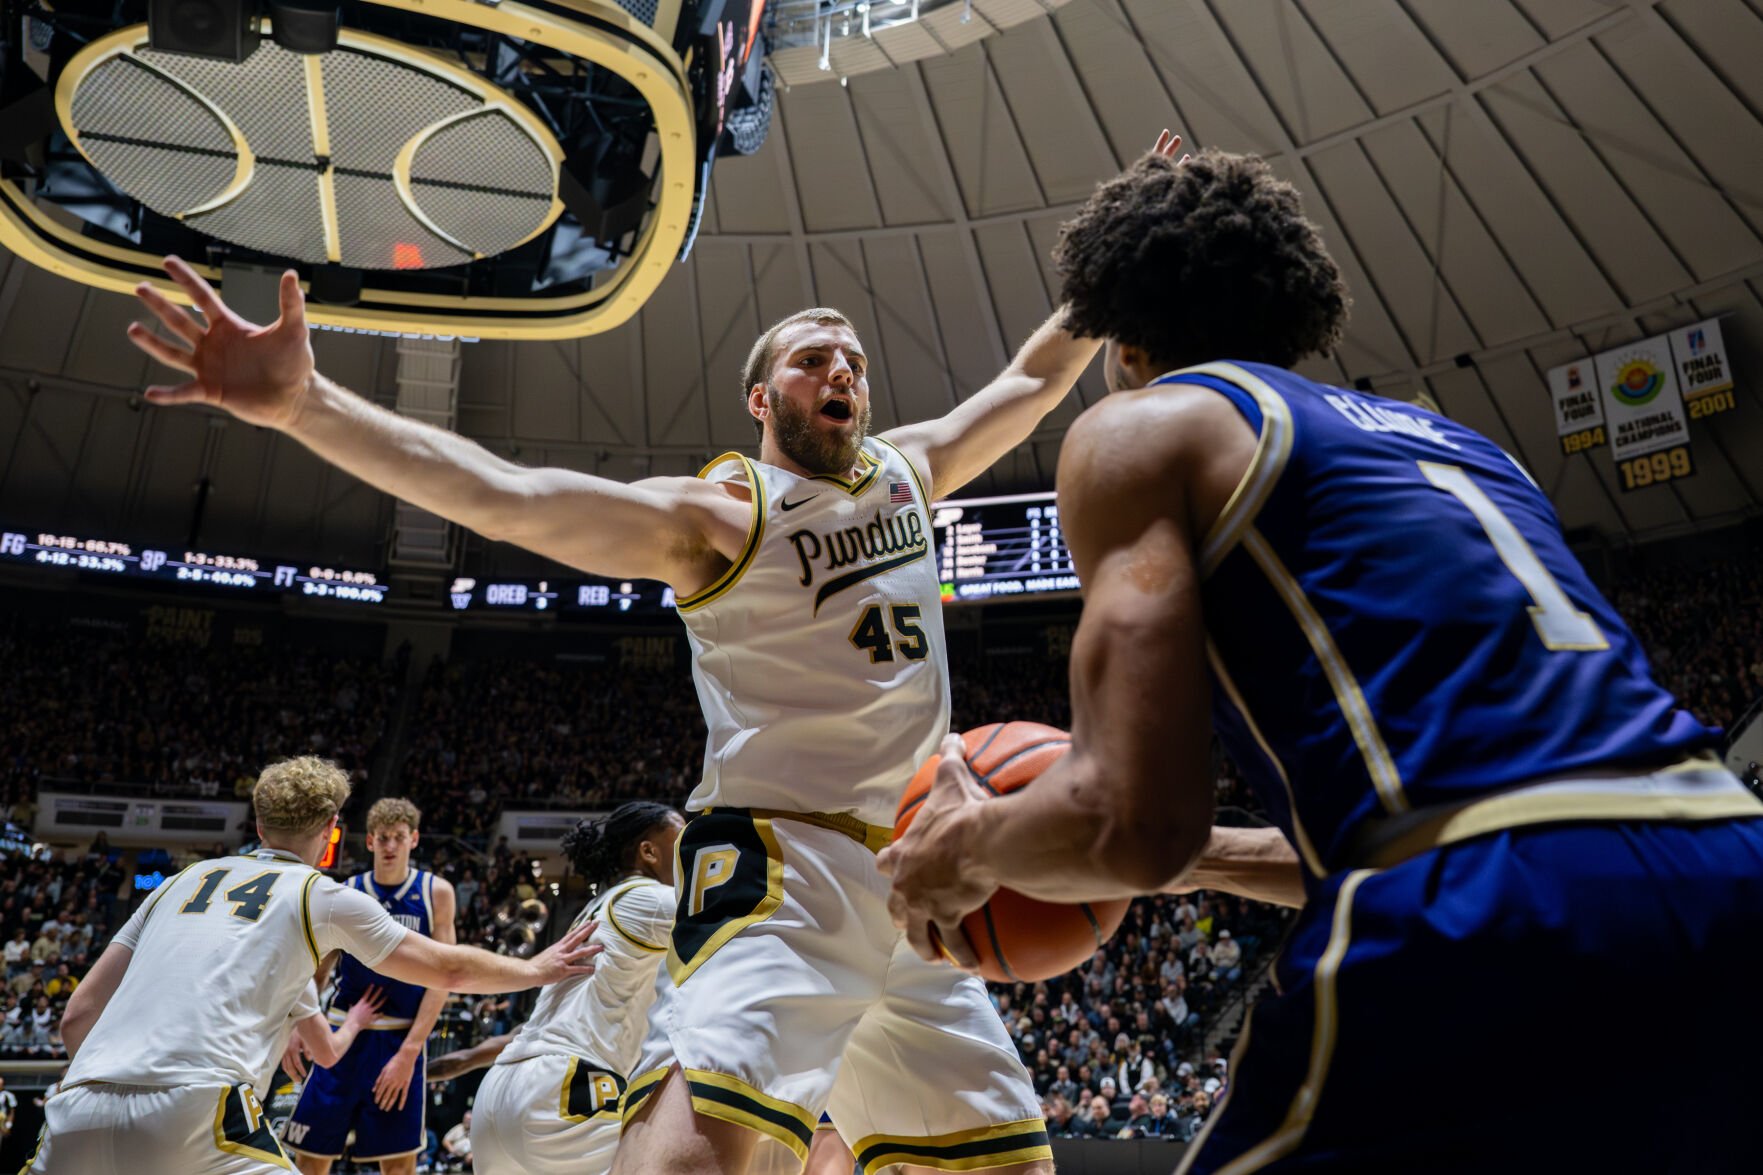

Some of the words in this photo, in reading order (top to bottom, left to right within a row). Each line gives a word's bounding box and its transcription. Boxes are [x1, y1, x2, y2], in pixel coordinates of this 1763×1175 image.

[1683, 354, 1722, 373] FINAL
[1688, 367, 1723, 387] FOUR
[1559, 391, 1595, 410] FINAL
[1688, 391, 1736, 420] 2001
[1564, 404, 1596, 422] FOUR
[1618, 411, 1675, 433] NATIONAL
[1563, 427, 1606, 454] 1994
[1616, 420, 1682, 446] CHAMPIONS
[1620, 447, 1692, 490] 1999
[0, 533, 27, 555] FG
[786, 509, 928, 588] Purdue
[1416, 460, 1610, 651] 1
[140, 550, 167, 572] 3P
[275, 566, 298, 587] FT
[487, 585, 528, 604] OREB
[579, 586, 609, 605] REB
[848, 603, 929, 665] 45
[688, 843, 742, 916] P
[178, 867, 283, 922] 14
[588, 1071, 621, 1111] P
[287, 1121, 311, 1145] W
